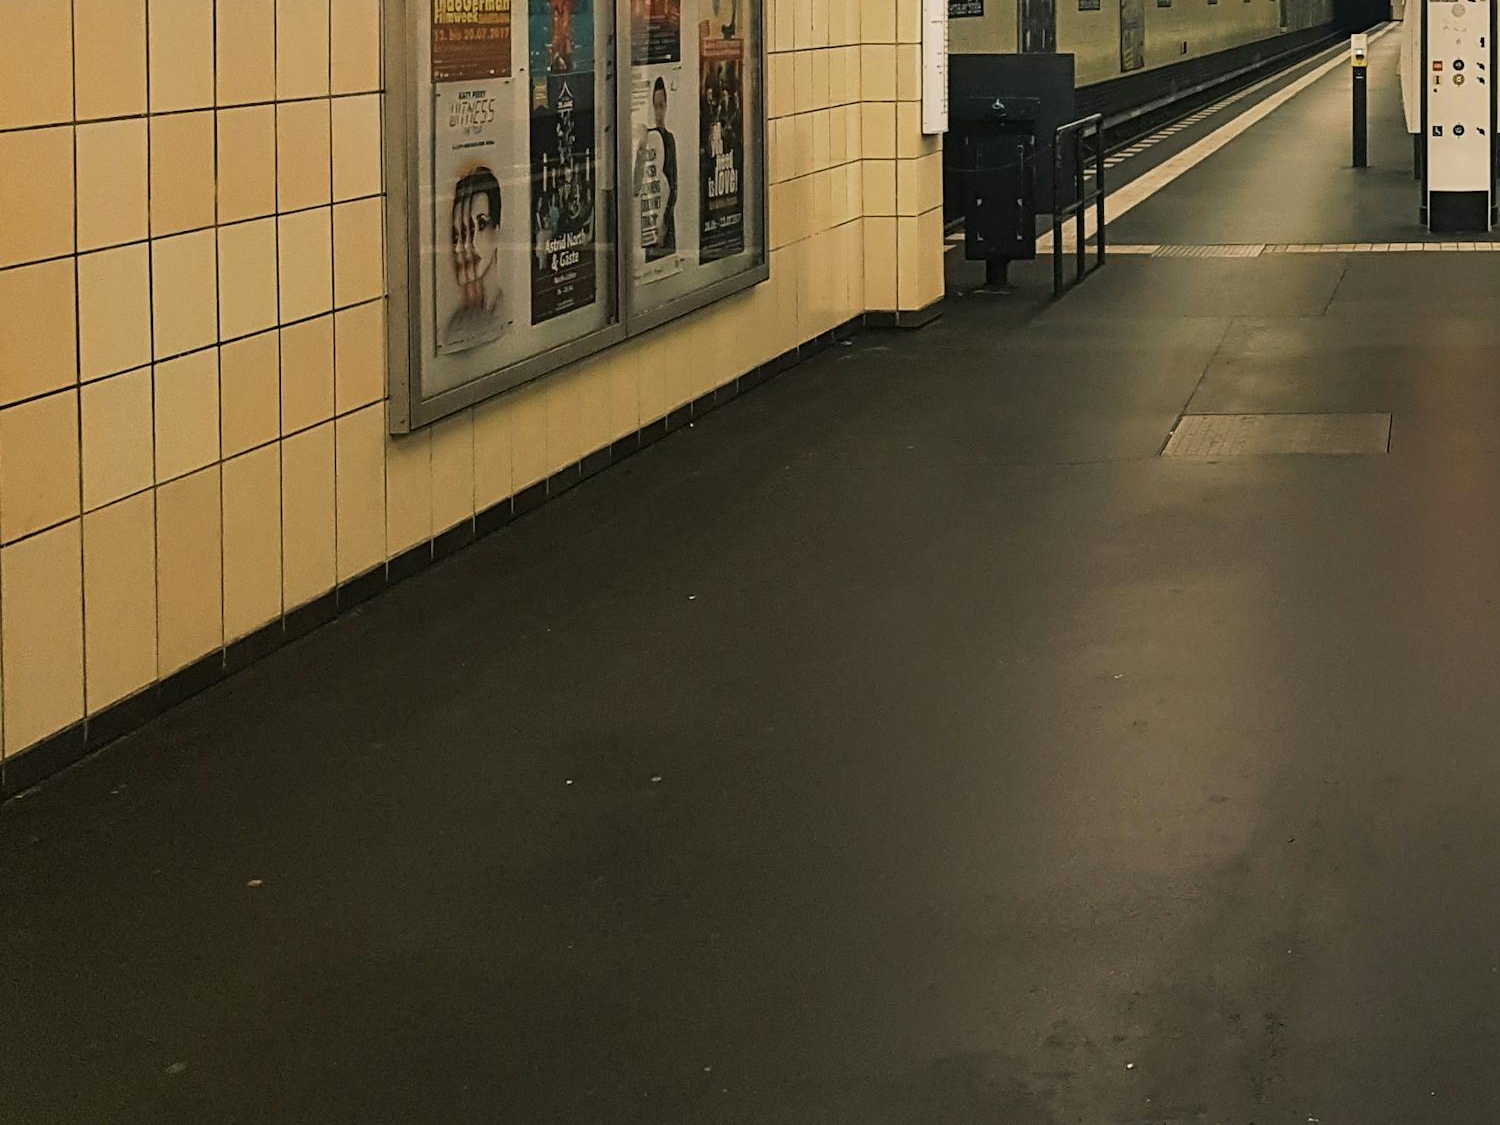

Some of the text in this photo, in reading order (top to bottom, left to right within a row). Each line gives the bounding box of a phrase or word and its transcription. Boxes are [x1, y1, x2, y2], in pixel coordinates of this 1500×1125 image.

[449, 98, 495, 127] WITNESS
[545, 233, 567, 254] Astrid
[551, 250, 579, 271] & Gäste
